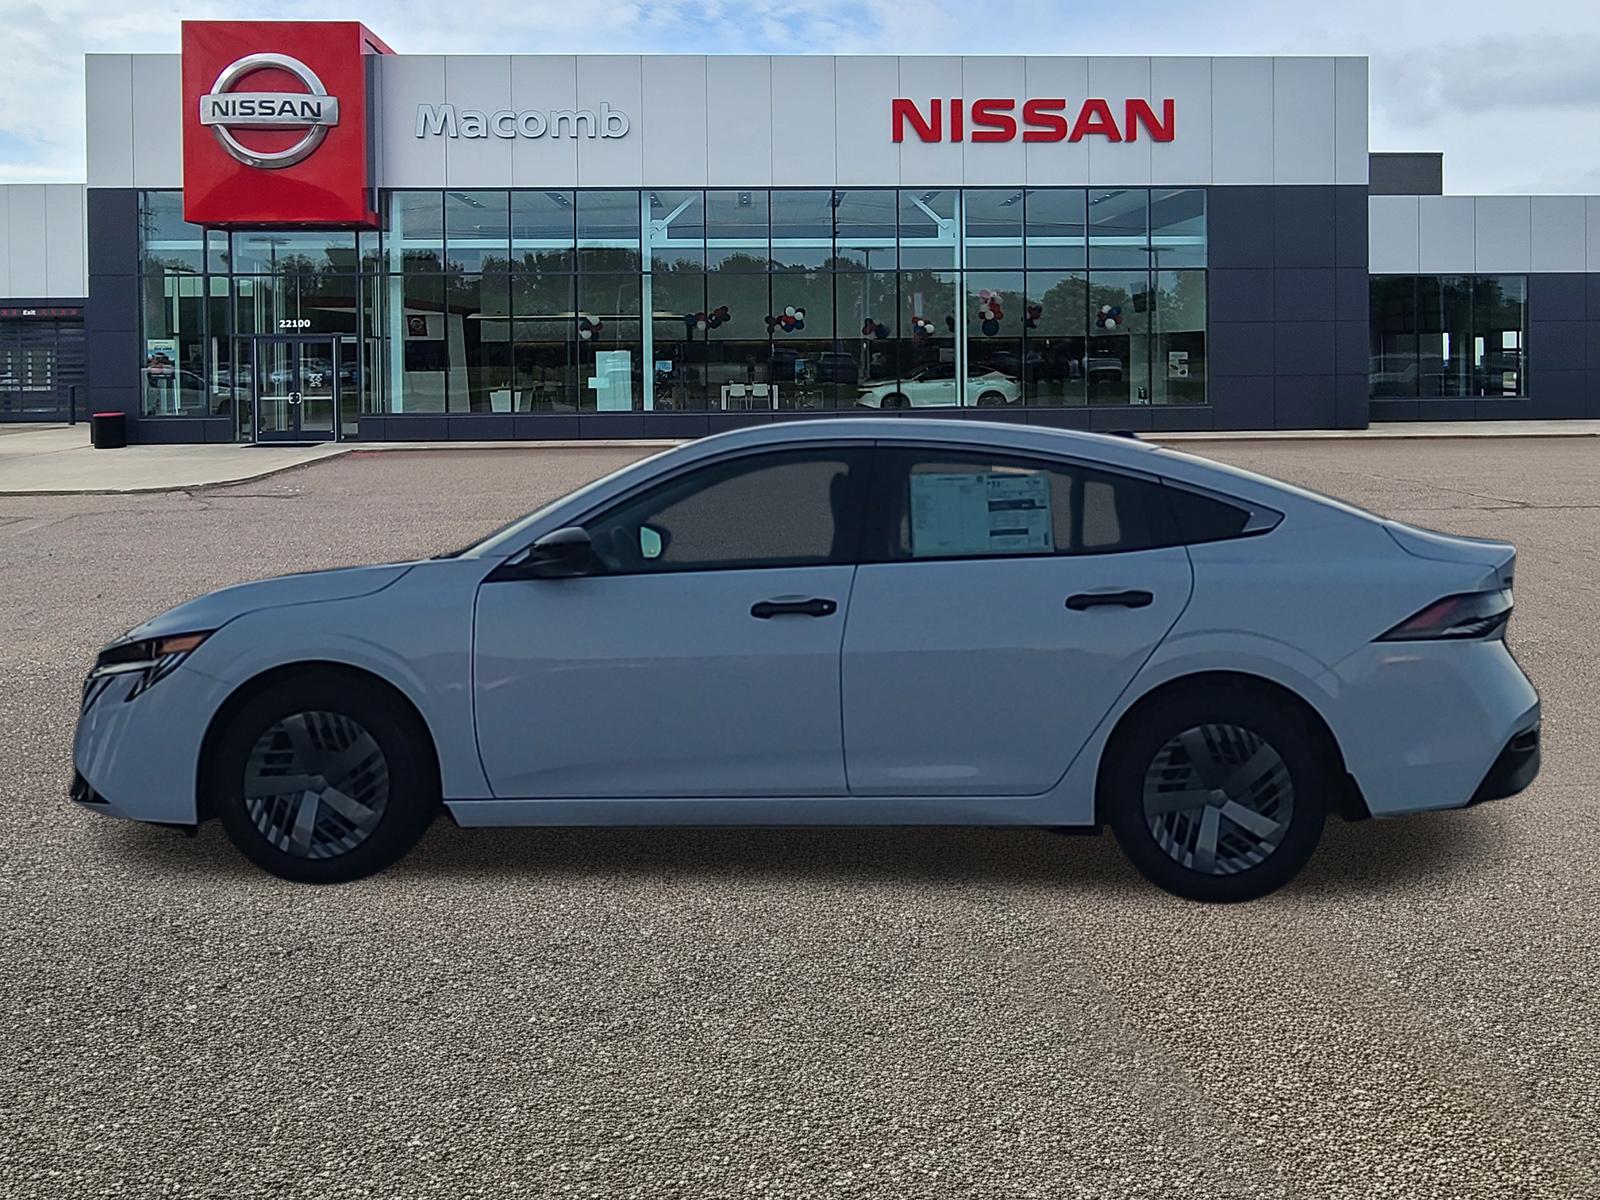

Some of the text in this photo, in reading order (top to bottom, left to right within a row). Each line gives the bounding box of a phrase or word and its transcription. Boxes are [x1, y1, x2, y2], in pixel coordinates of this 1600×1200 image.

[211, 100, 322, 118] NISSAN
[415, 101, 630, 139] Macomb
[891, 98, 1176, 143] NISSAN
[279, 319, 311, 328] 22100
